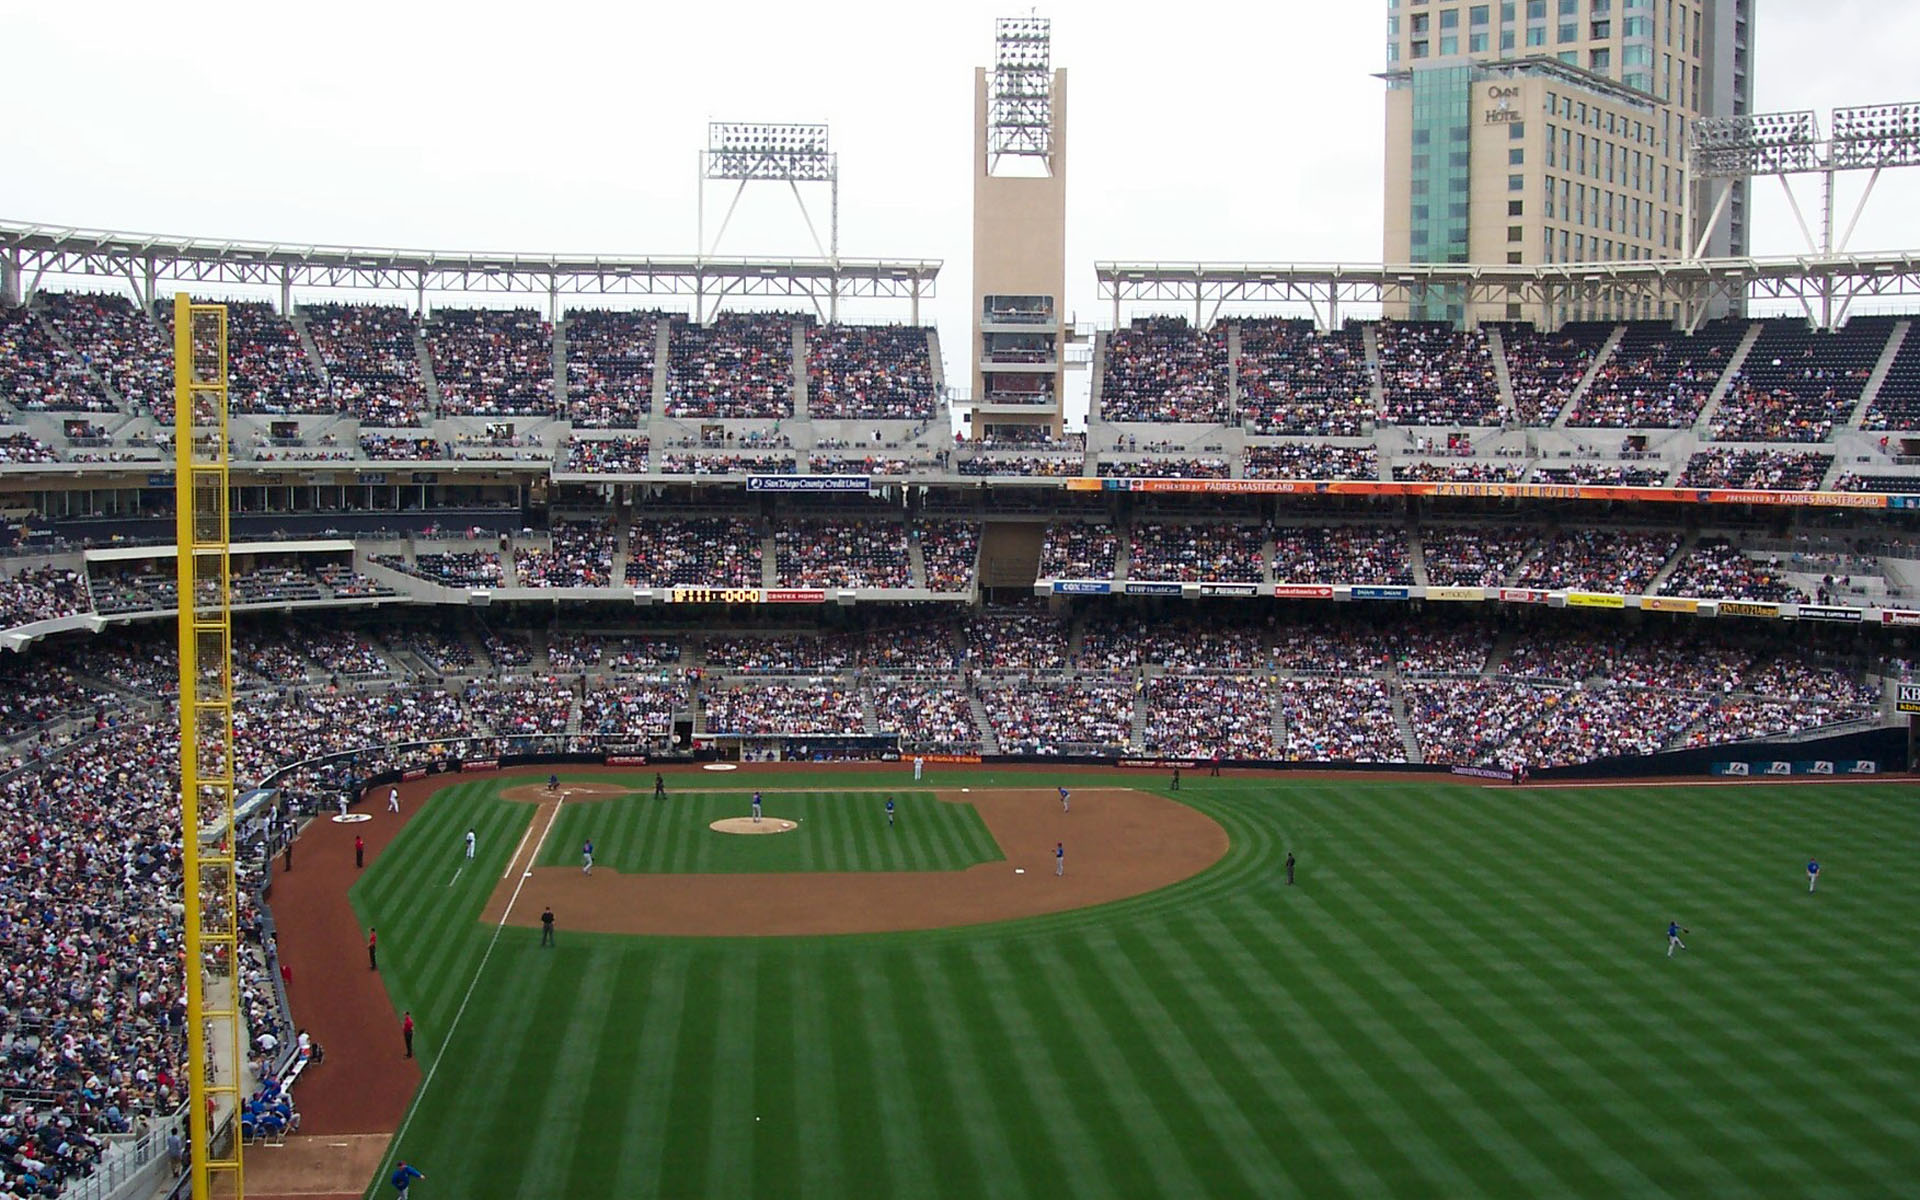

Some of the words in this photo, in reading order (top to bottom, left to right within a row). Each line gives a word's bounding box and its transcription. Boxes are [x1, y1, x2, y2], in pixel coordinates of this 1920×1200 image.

[764, 479, 778, 488] San
[778, 479, 799, 489] Diego
[799, 479, 825, 489] County
[845, 479, 867, 488] Union
[1204, 482, 1237, 491] PADRES
[1237, 482, 1294, 492] MASTERCARD
[1436, 485, 1505, 496] PADRES
[1779, 494, 1814, 504] PADRES
[1815, 496, 1878, 506] MASTERCARD
[1062, 583, 1081, 591] COX
